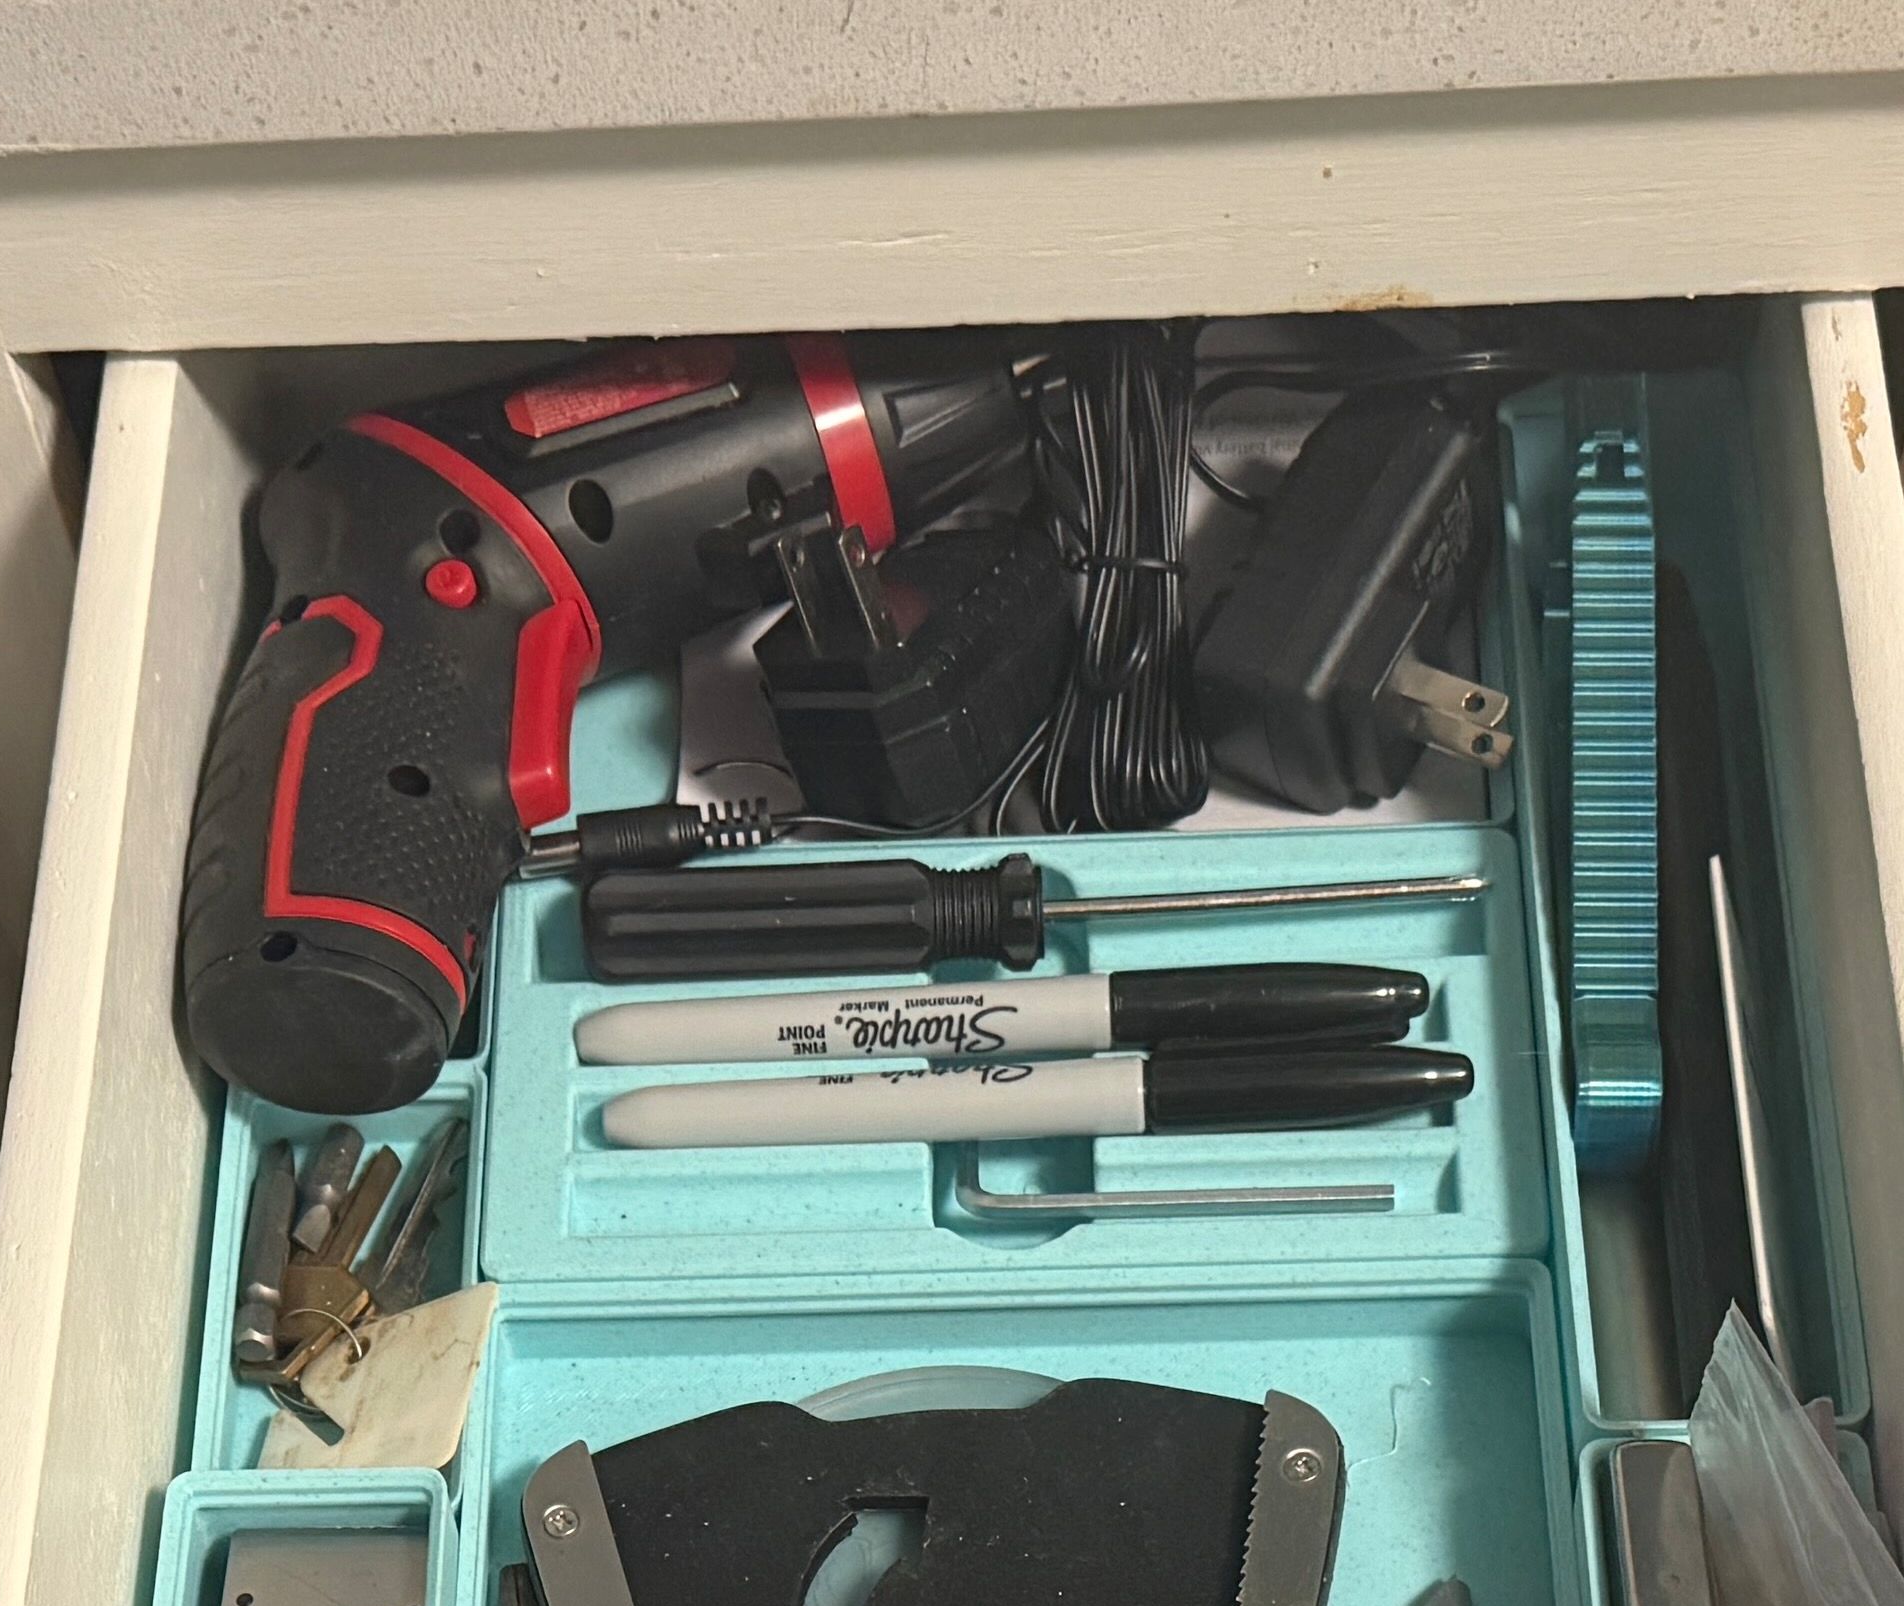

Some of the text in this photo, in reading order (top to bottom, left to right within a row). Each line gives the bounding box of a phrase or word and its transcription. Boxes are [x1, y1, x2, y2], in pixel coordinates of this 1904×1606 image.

[839, 995, 984, 1012] Permanent Marker
[777, 1025, 826, 1041] POINT
[845, 1006, 1018, 1054] Sharpie
[793, 1041, 827, 1055] FINE
